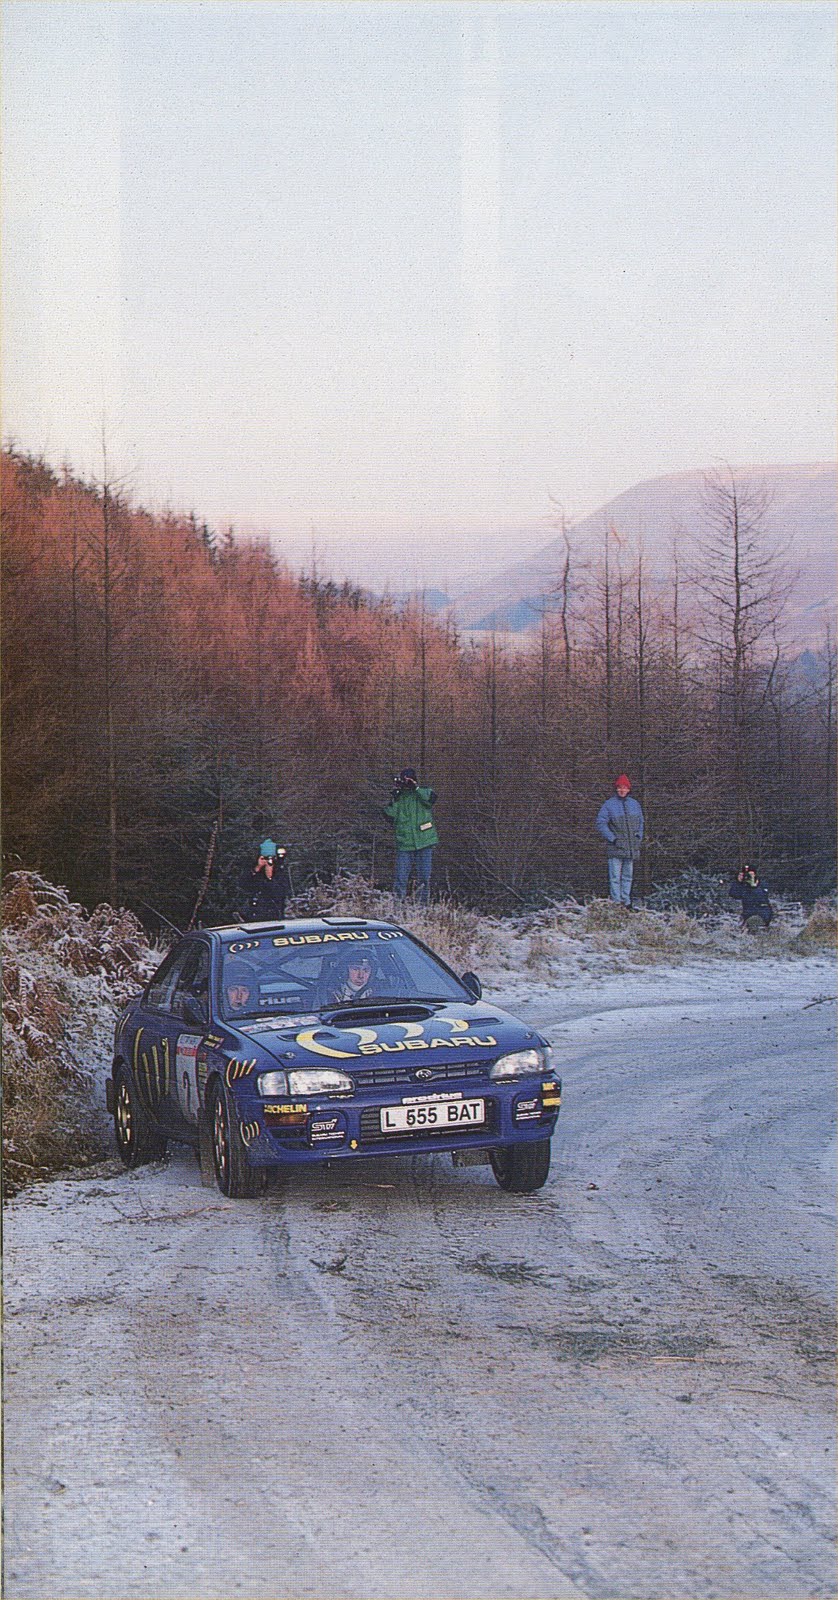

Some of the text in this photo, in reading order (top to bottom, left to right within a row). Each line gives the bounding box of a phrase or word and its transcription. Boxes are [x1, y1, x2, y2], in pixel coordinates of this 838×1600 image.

[272, 931, 369, 947] SUBARU
[358, 1035, 497, 1055] SUBARU
[385, 1102, 480, 1128] L 555 BAT
